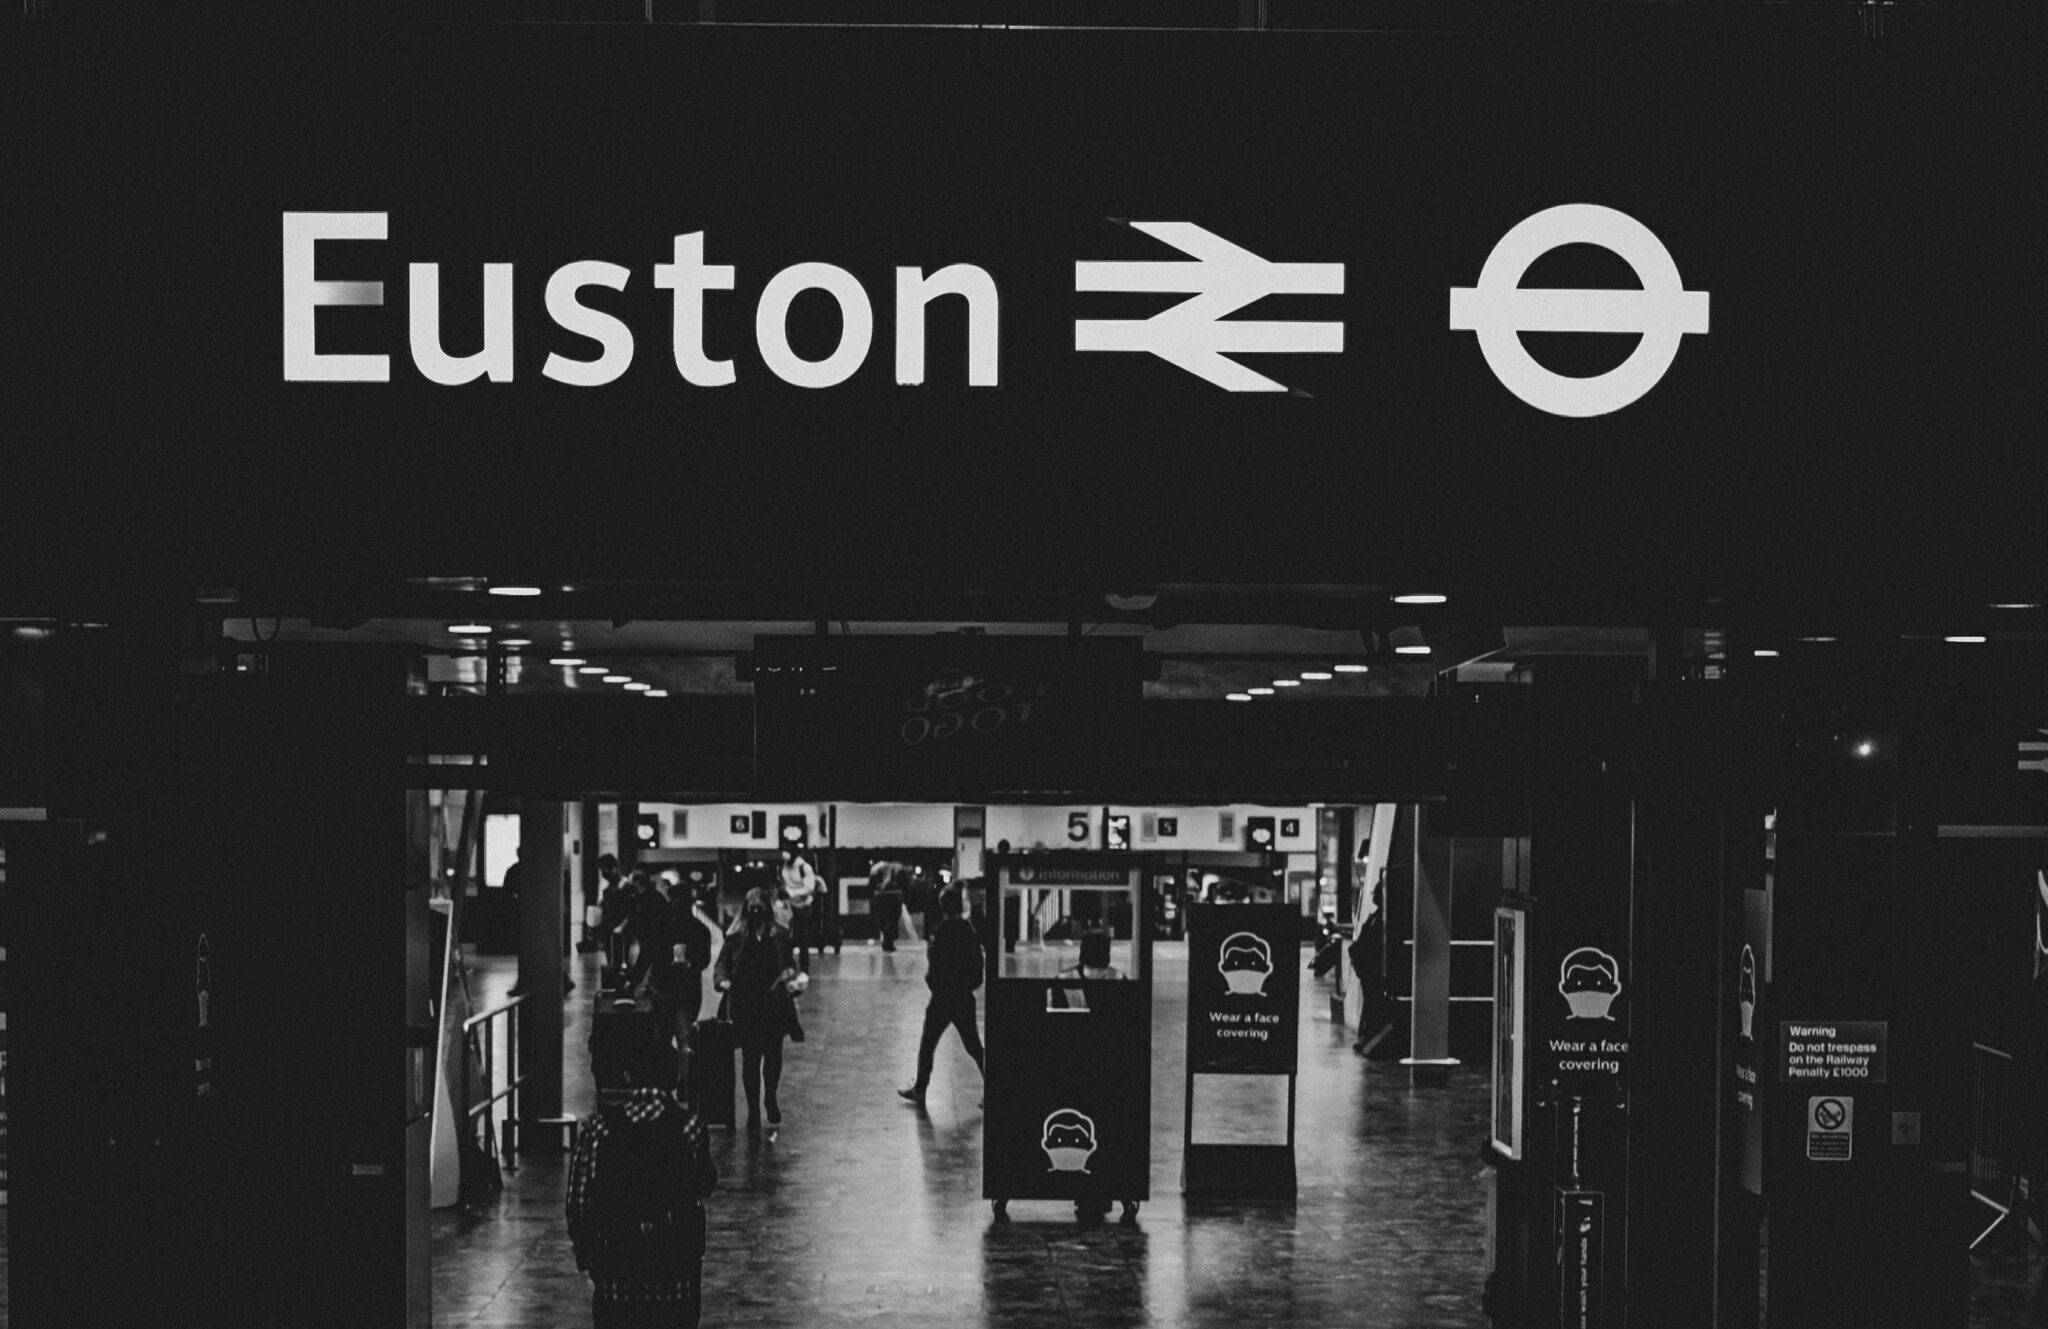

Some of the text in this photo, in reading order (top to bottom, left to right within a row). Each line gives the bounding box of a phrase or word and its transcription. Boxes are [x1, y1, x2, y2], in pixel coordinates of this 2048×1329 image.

[283, 210, 999, 389] Euston
[1068, 812, 1089, 842] 5
[1163, 821, 1172, 833] 5
[1285, 822, 1294, 833] 4
[1209, 1011, 1280, 1023] Wear a face
[1216, 1028, 1268, 1041] covering
[1789, 1026, 1836, 1038] Warning
[1549, 1039, 1628, 1052] Wear a face
[1789, 1042, 1877, 1054] Do not trespass
[1559, 1057, 1619, 1074] covering
[1789, 1055, 1869, 1067] on the Railway
[1789, 1067, 1868, 1079] Penalty £1000
